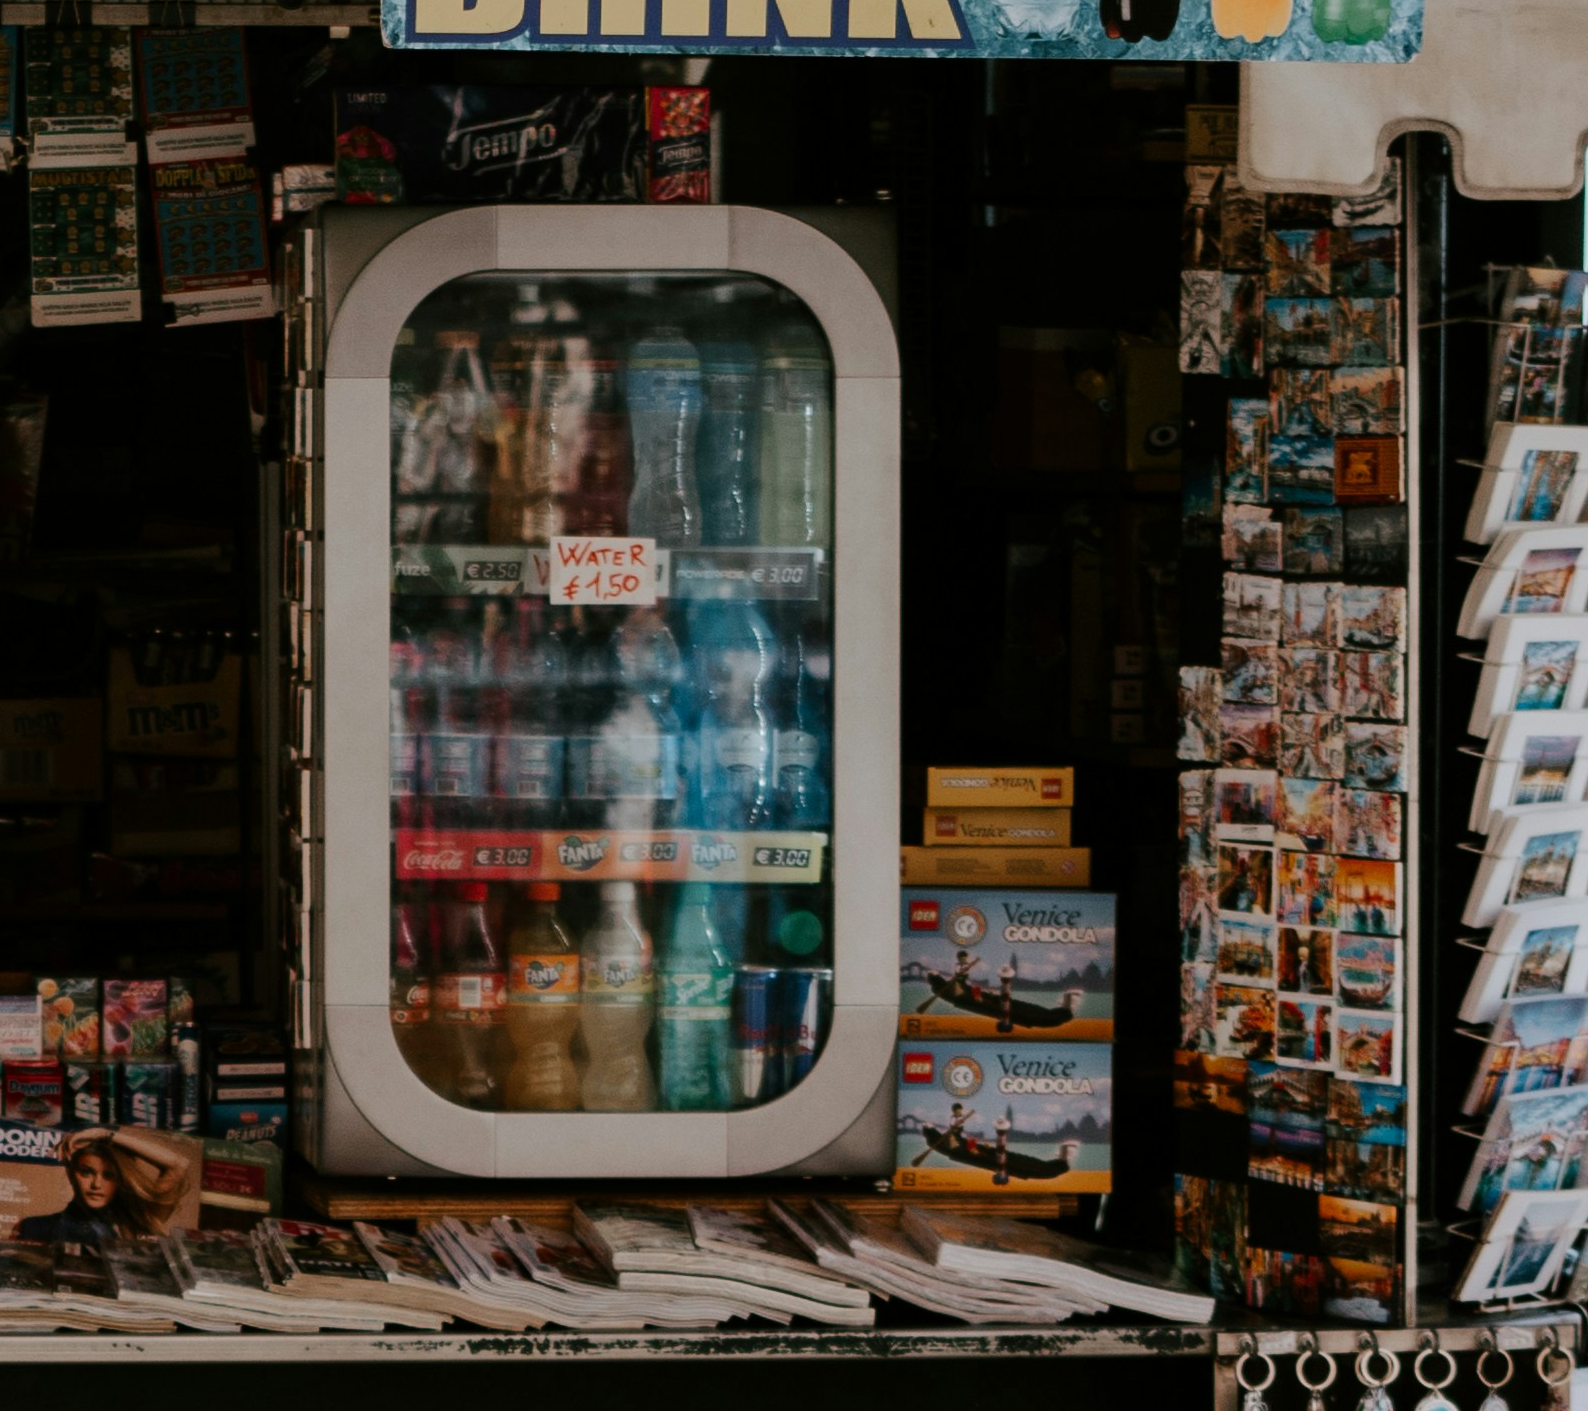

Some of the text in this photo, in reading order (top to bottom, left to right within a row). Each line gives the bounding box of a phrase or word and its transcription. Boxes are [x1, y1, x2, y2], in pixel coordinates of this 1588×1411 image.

[448, 124, 557, 172] Tempo
[558, 541, 648, 568] WATER
[394, 561, 431, 577] fuze
[585, 573, 640, 599] 1,50
[960, 823, 1007, 838] Venice
[558, 836, 605, 863] FANTA
[691, 842, 737, 863] FANTA
[772, 848, 809, 866] 3.00
[1002, 903, 1081, 926] Venice
[1004, 927, 1097, 944] GONDOLA
[525, 969, 559, 985] FANTA
[997, 1054, 1076, 1077] Venice
[999, 1079, 1093, 1095] GONDOLA
